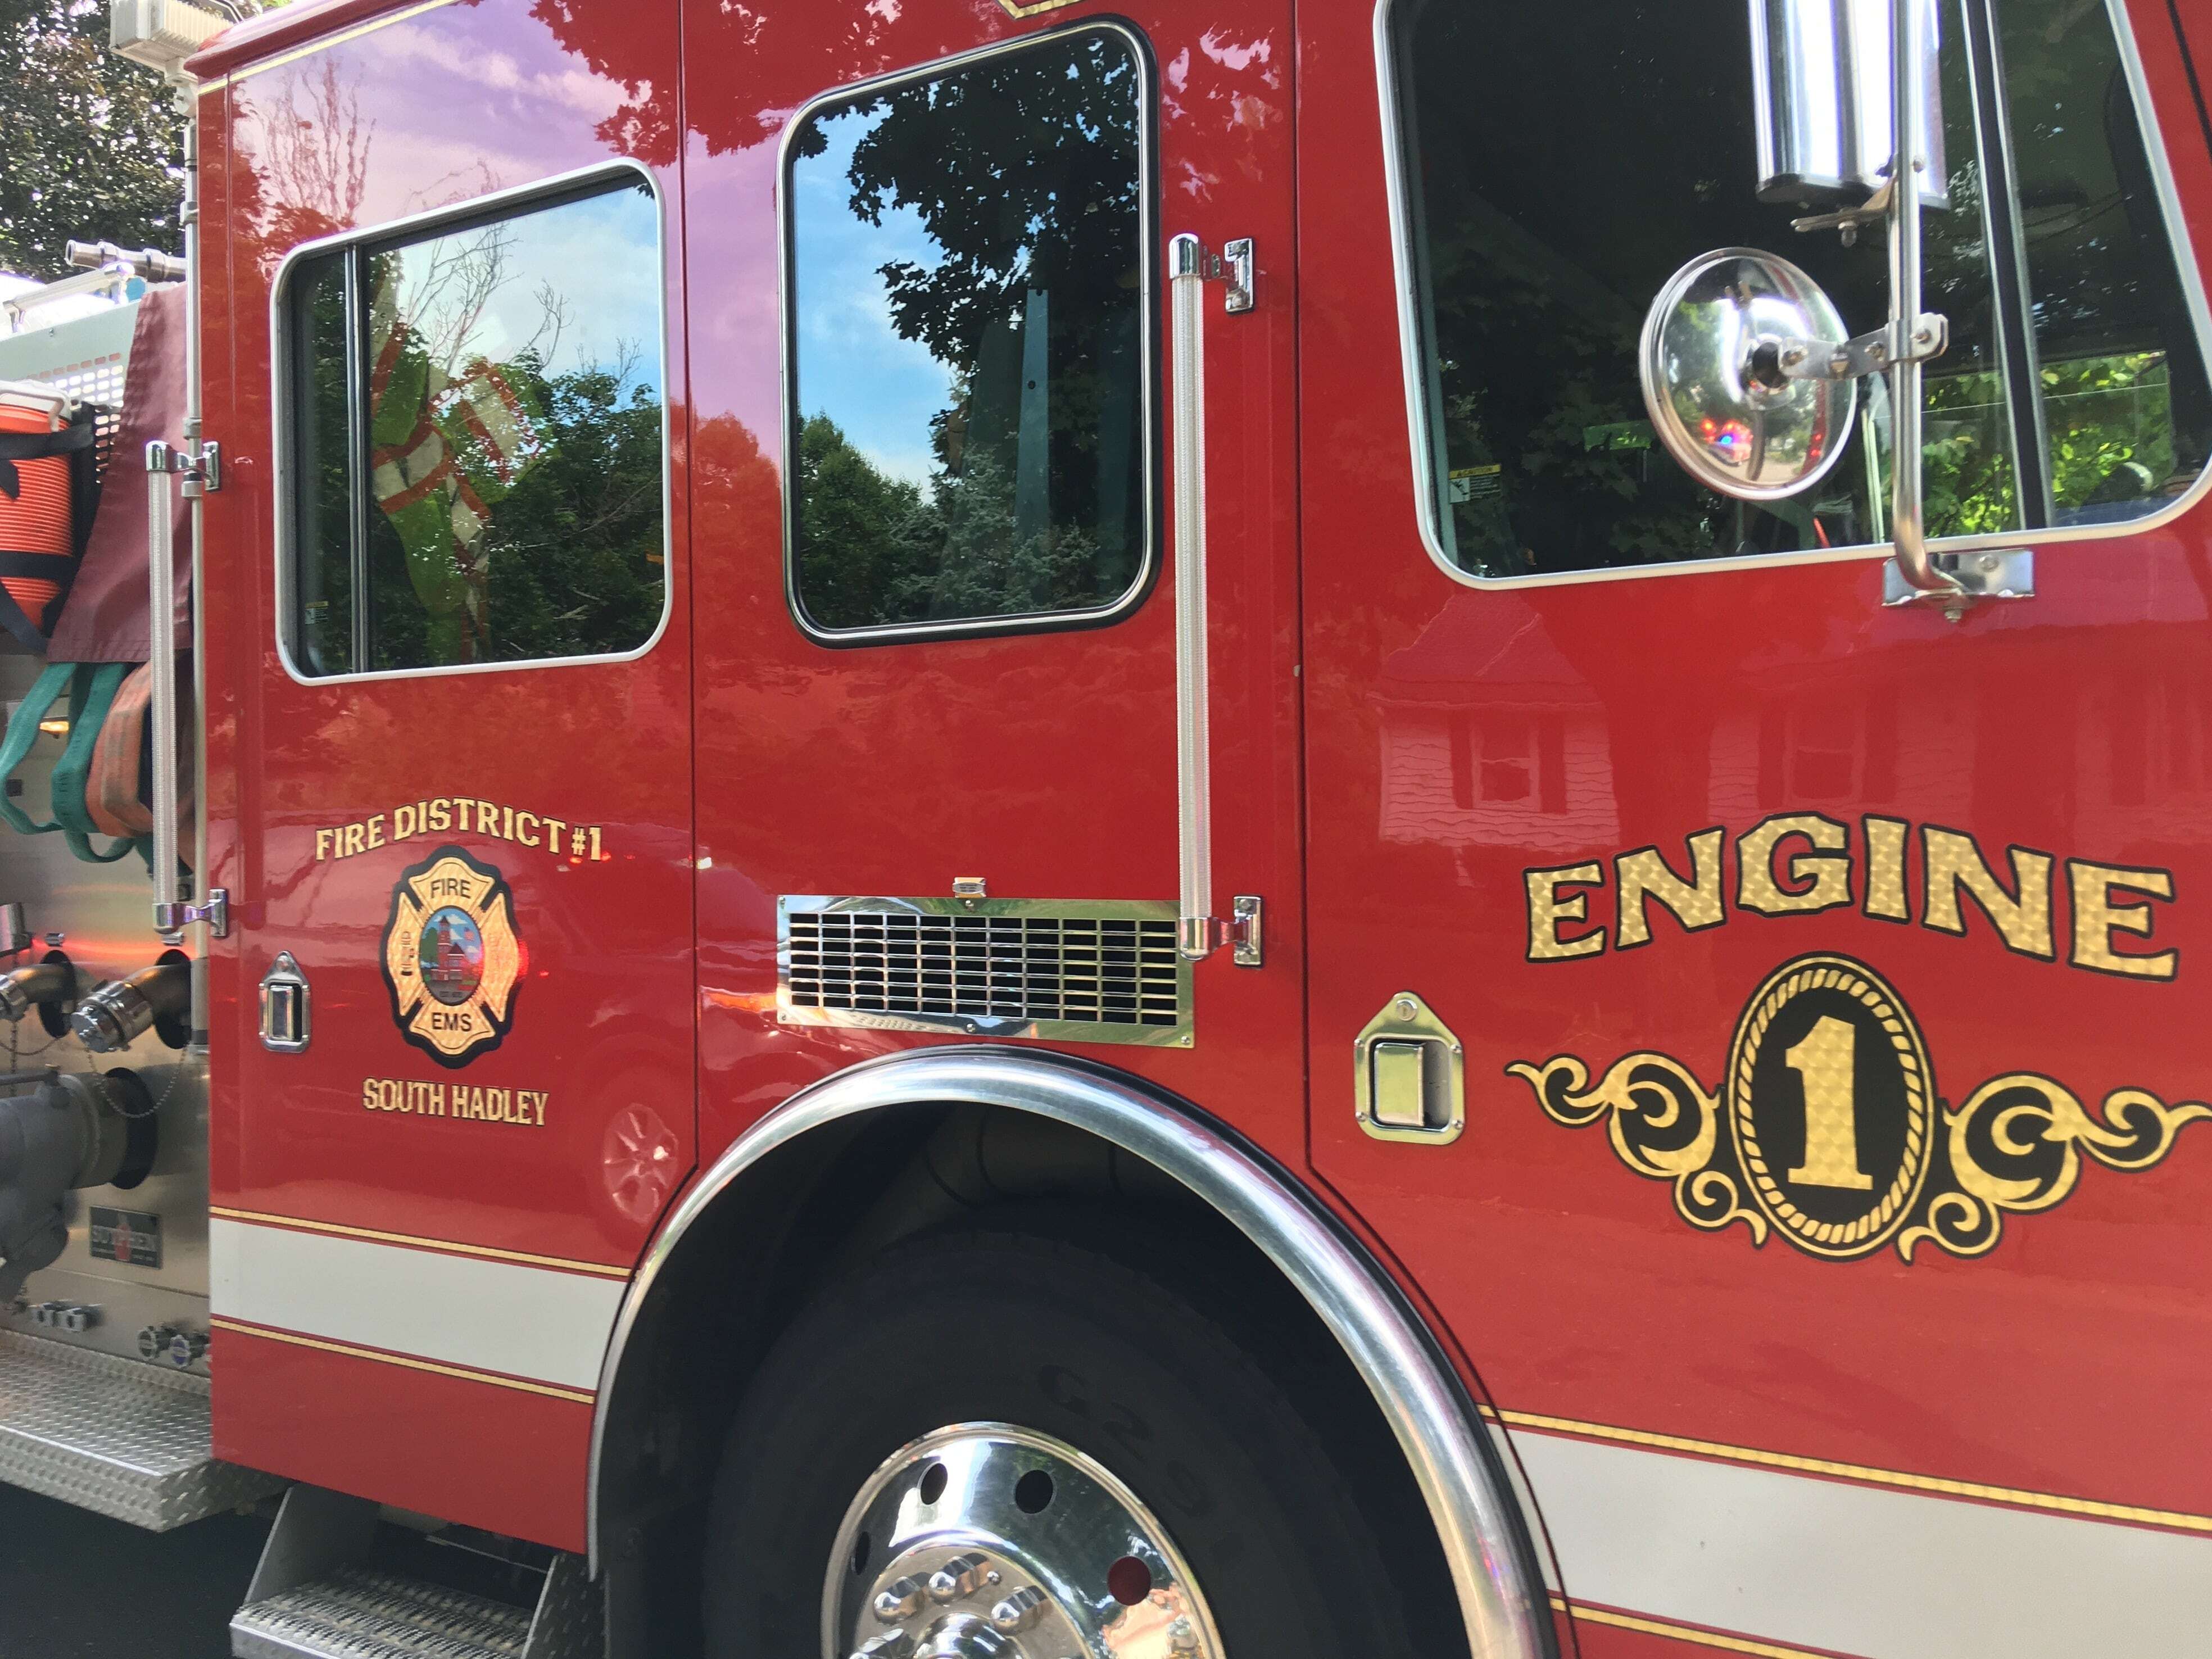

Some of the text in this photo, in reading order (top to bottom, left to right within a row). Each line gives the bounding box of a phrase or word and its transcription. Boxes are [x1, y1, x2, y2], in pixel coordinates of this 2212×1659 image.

[316, 796, 602, 860] FIRE DISTRICT #1
[430, 878, 471, 899] FIRE
[1523, 810, 2179, 982] ENGINE
[432, 1012, 473, 1032] EMS
[362, 1077, 550, 1126] SOUTH HADLEY
[1785, 1014, 1874, 1190] 1
